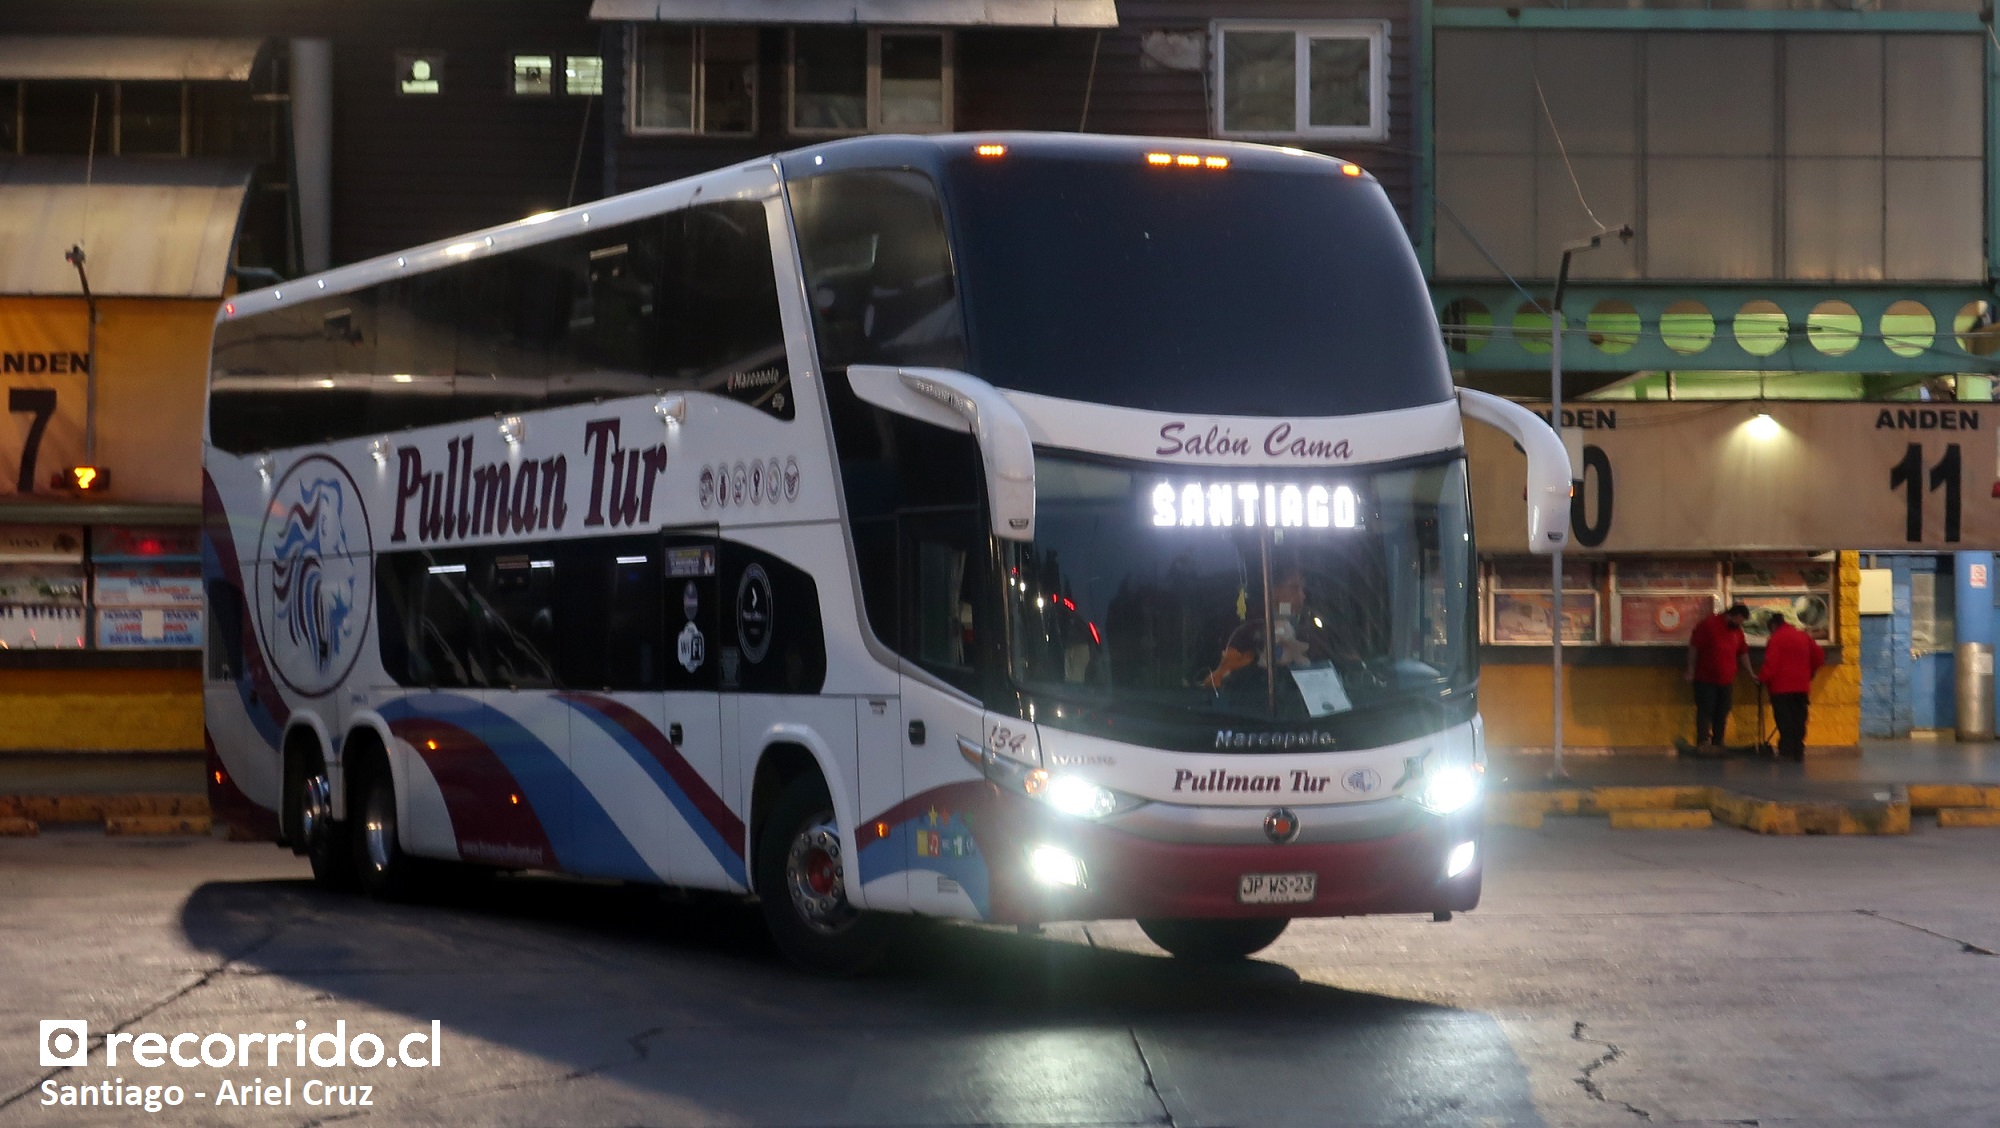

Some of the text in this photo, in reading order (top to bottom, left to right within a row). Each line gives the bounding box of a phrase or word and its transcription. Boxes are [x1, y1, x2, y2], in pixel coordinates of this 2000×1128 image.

[0, 353, 89, 374] NDEN
[1876, 410, 1979, 430] ANDEN
[9, 388, 57, 493] 7
[1156, 421, 1353, 460] Salón Cama
[390, 417, 668, 544] Pullman Tur
[1890, 443, 1962, 542] 11
[1152, 482, 1356, 528] SANTIAGO
[1214, 729, 1333, 748] Marcopolo
[1172, 769, 1331, 793] Pullman Tur
